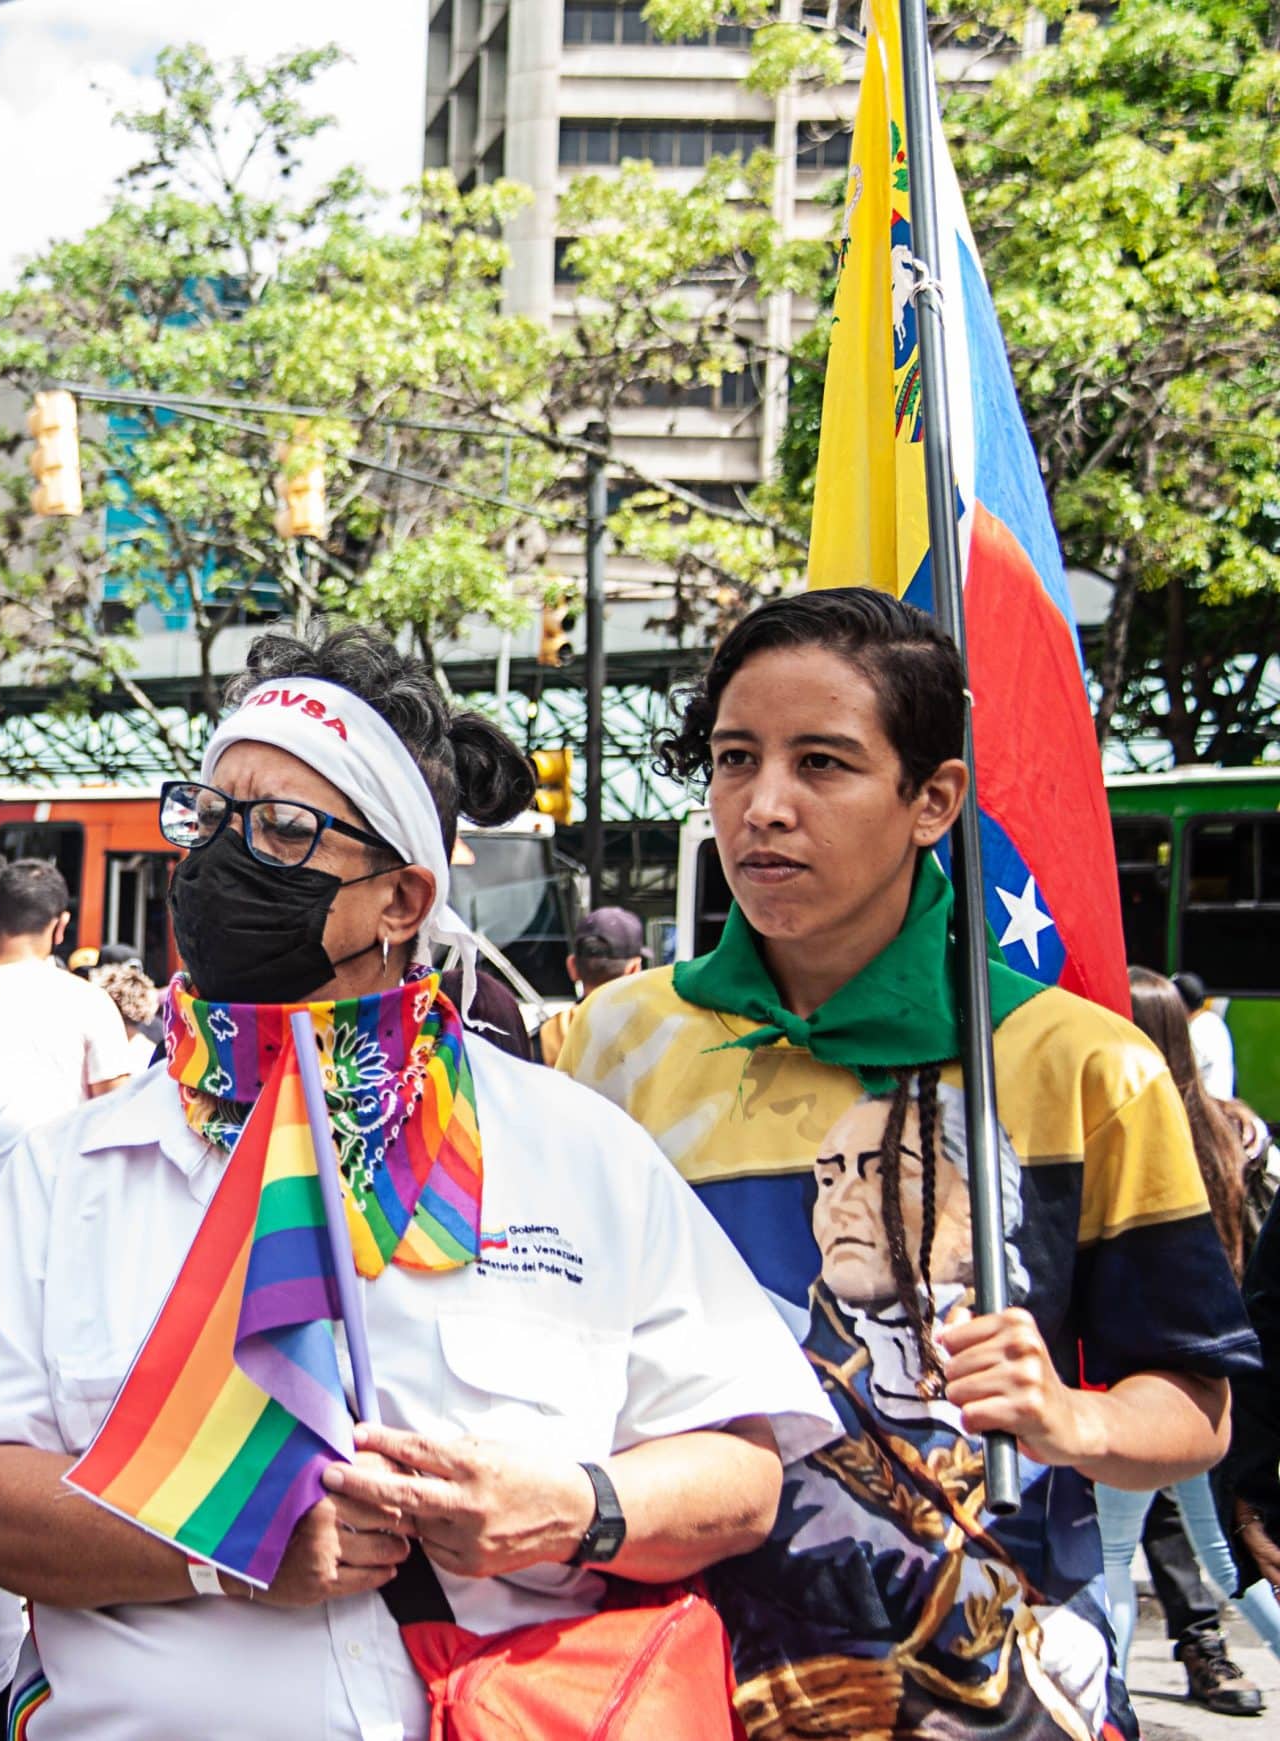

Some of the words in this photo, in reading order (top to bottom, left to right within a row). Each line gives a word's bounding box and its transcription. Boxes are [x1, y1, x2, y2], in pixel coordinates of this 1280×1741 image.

[245, 689, 348, 742] PDVSA
[511, 1245, 528, 1255] de
[532, 1244, 584, 1266] Venezuela
[521, 1262, 537, 1273] del
[538, 1261, 563, 1277] Poder
